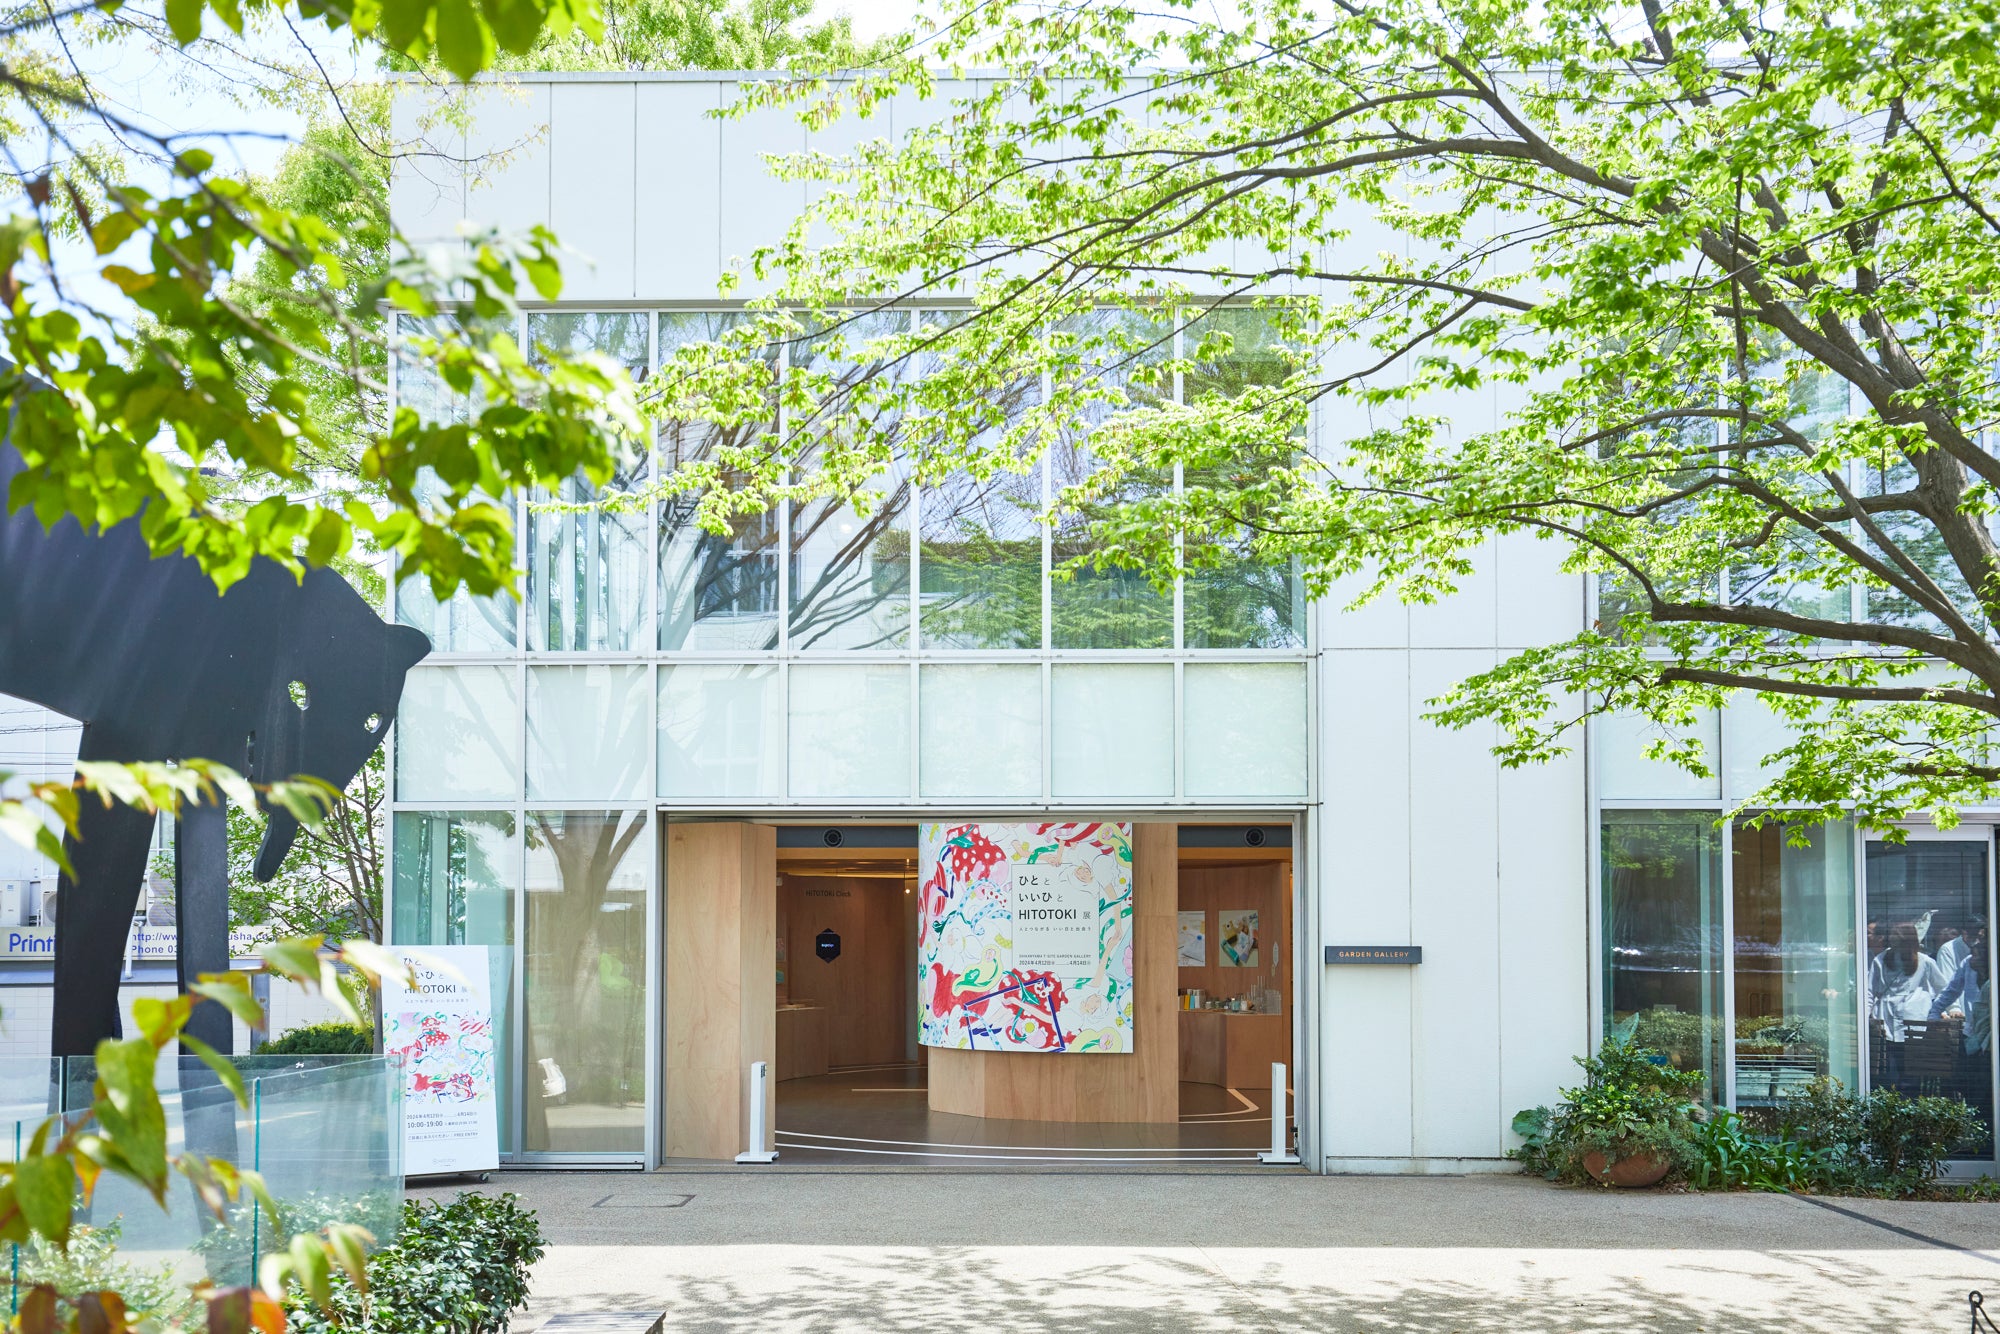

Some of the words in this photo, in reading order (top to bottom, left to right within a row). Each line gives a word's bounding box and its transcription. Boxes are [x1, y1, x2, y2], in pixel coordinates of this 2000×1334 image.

[1019, 875, 1038, 886] ひと
[1044, 878, 1050, 886] と
[1019, 892, 1053, 902] いいひ
[1057, 894, 1063, 902] と
[1018, 909, 1077, 920] HITOTOKI
[414, 971, 435, 980] いひ
[407, 1120, 443, 1129] 10:00-19:00
